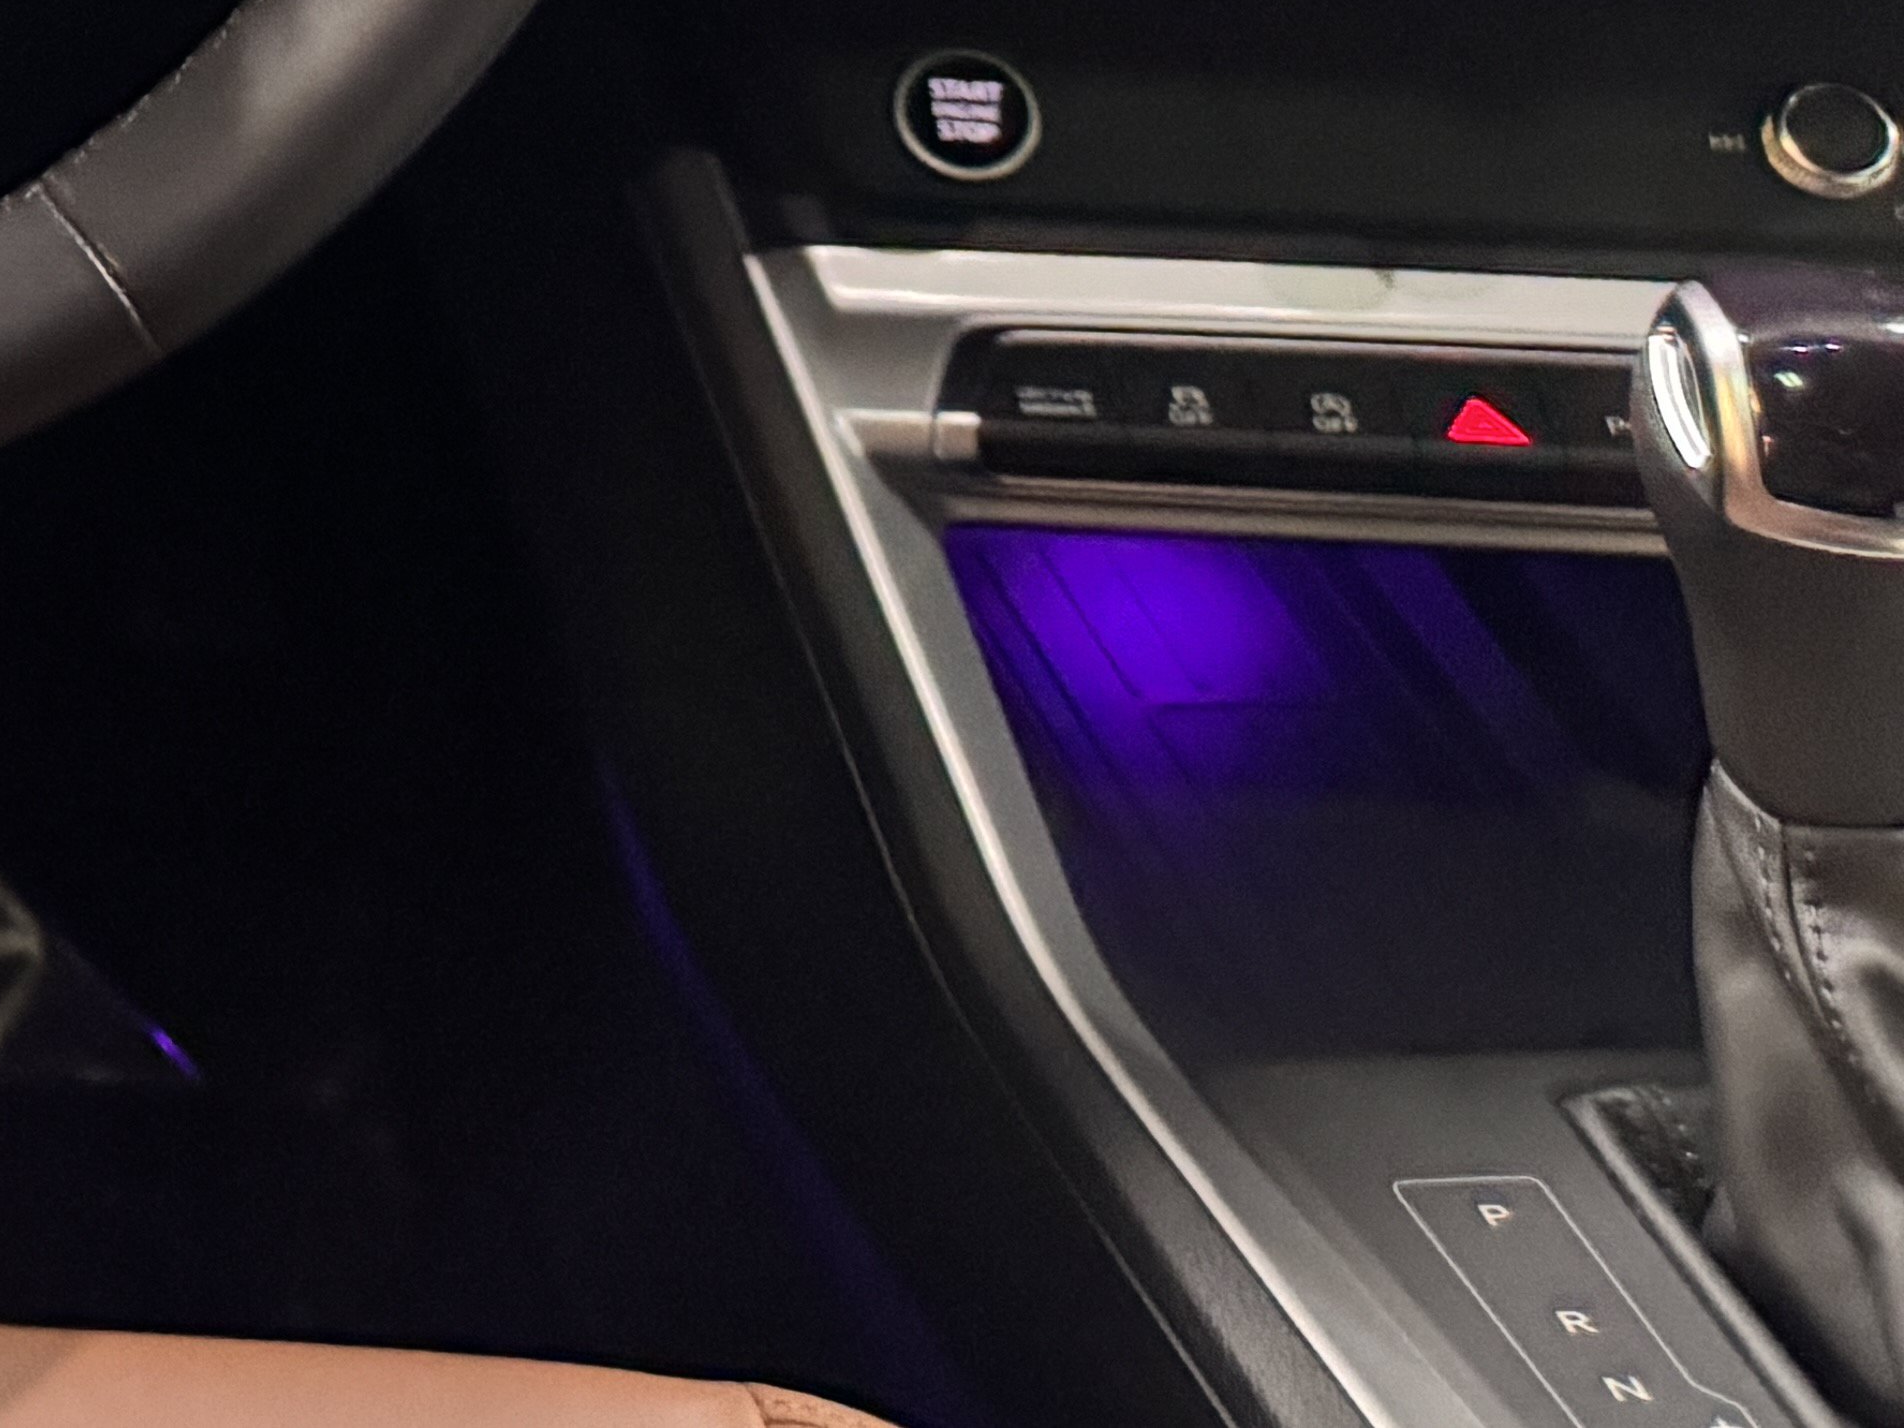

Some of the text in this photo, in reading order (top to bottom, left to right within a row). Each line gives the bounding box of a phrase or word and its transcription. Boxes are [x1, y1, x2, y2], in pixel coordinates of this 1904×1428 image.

[1475, 1203, 1514, 1228] P
[1554, 1309, 1601, 1337] R
[1601, 1375, 1655, 1404] N
